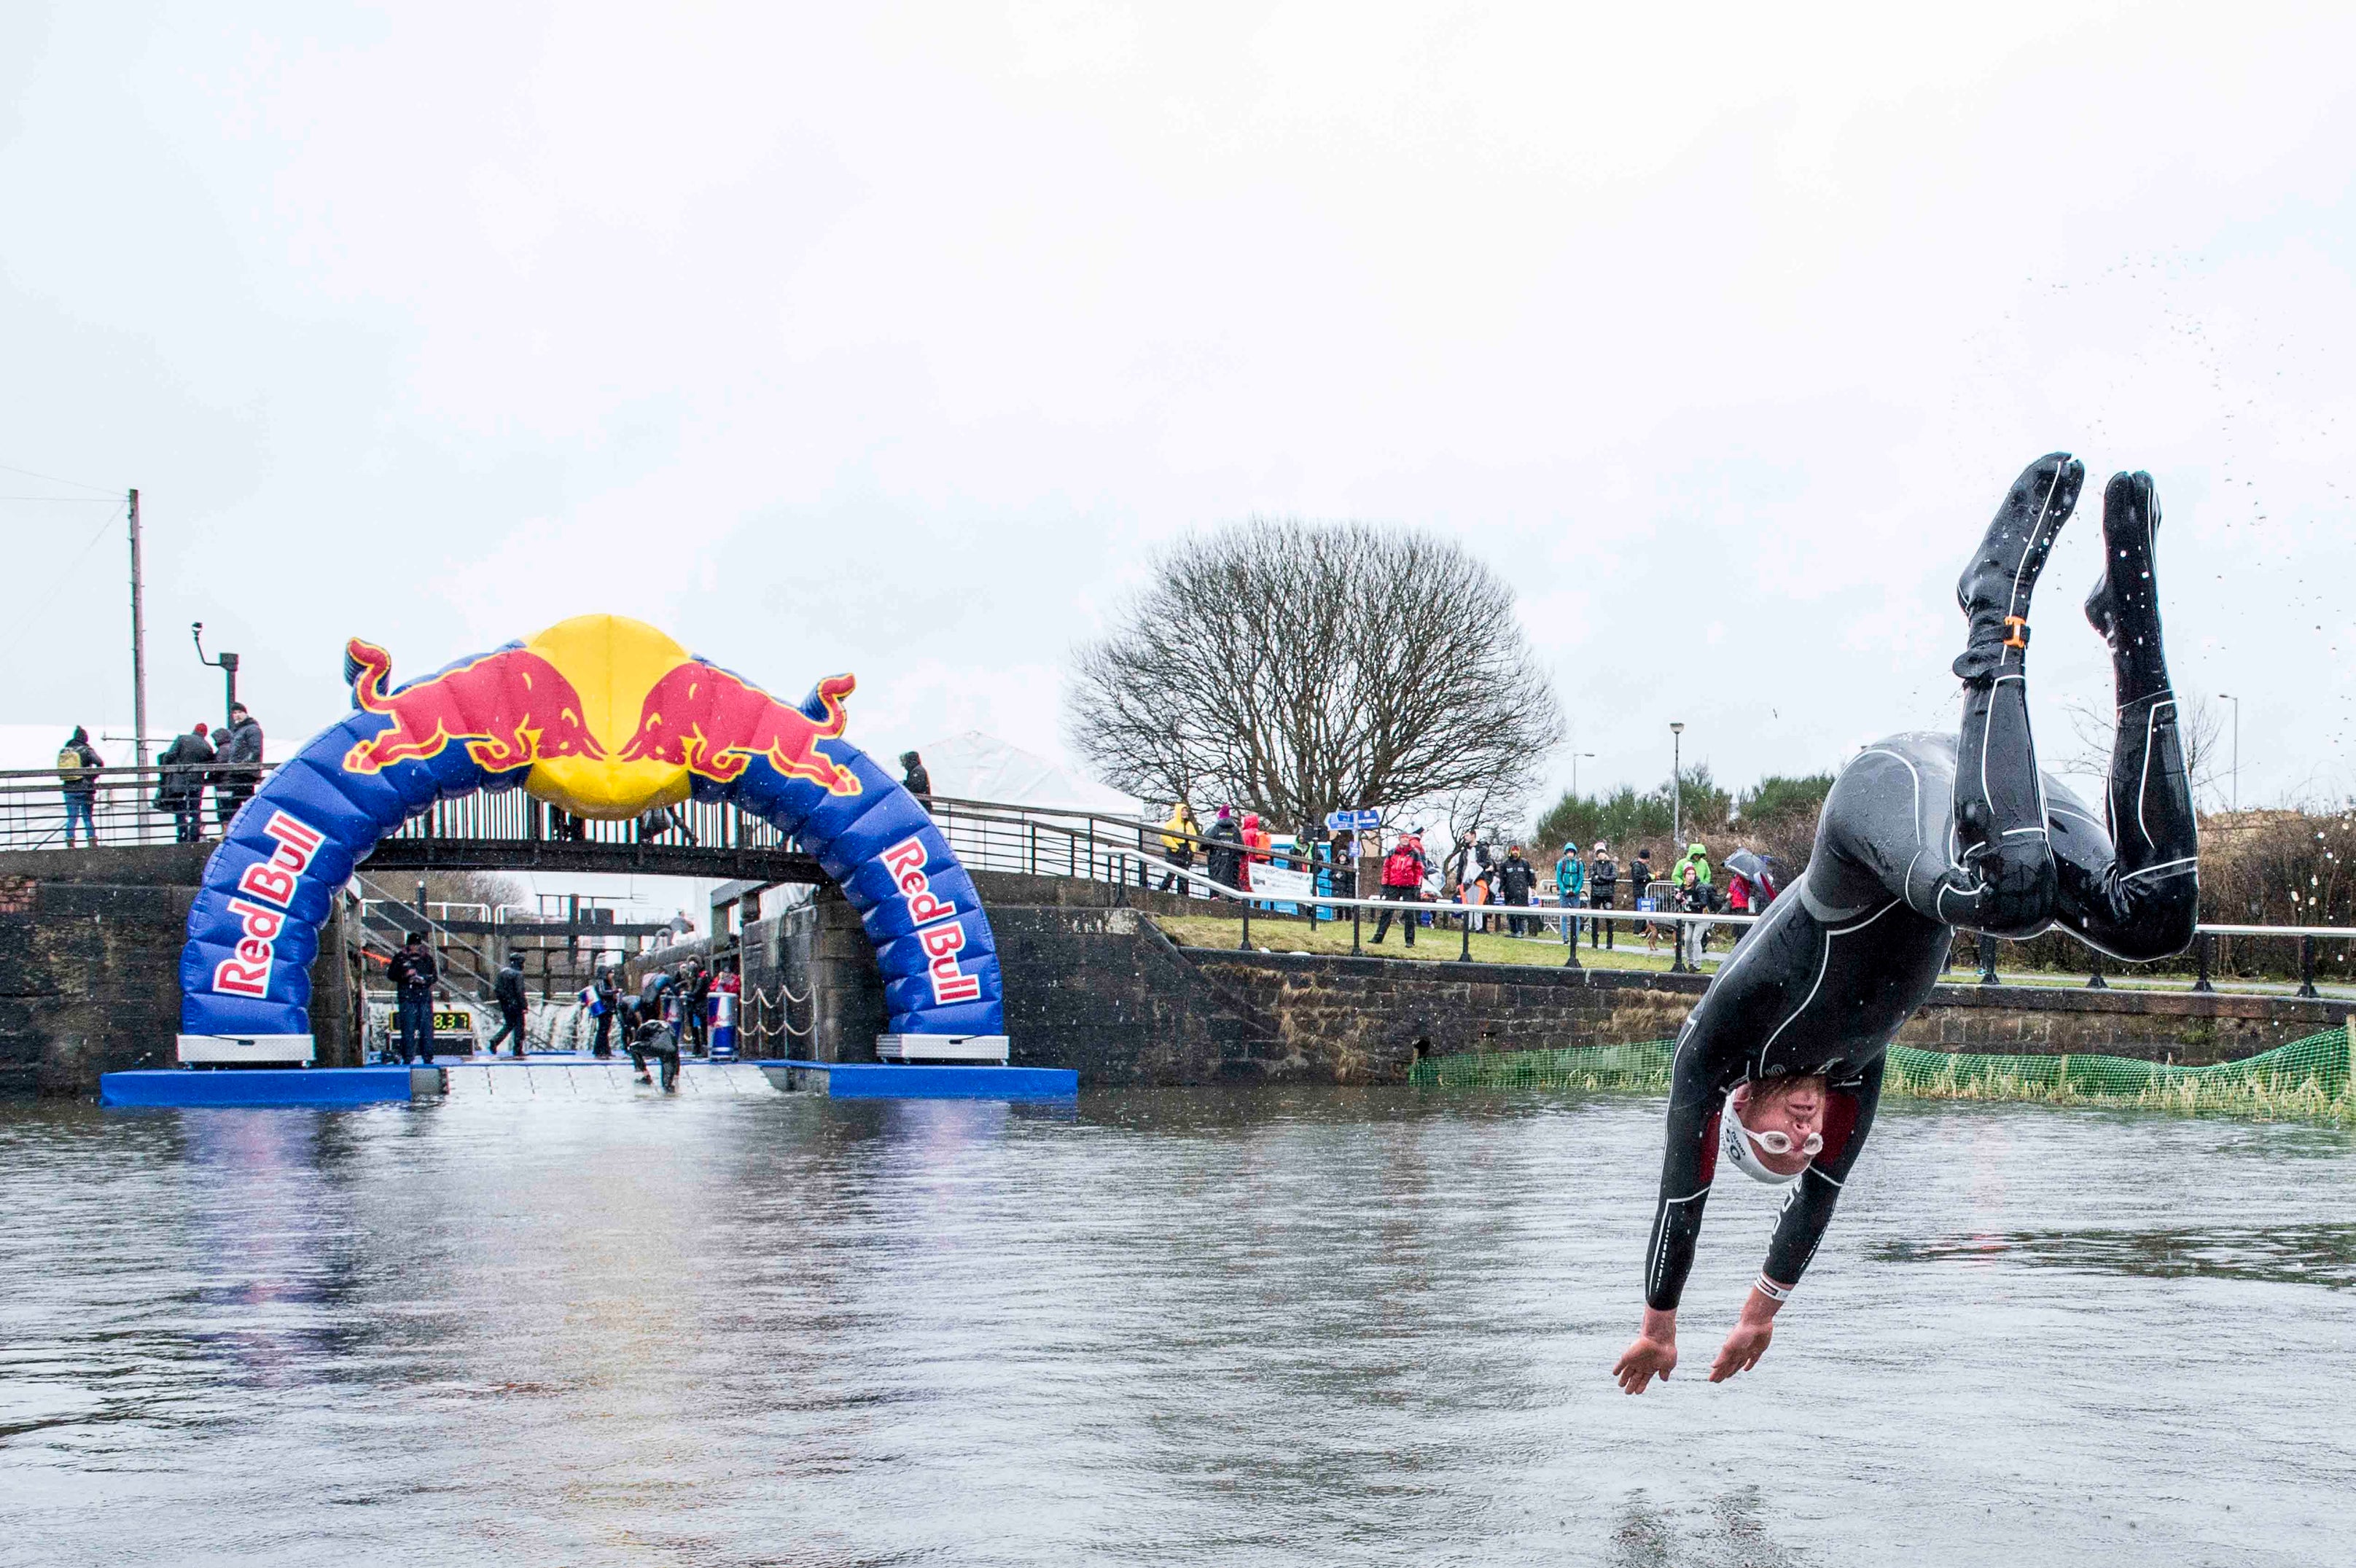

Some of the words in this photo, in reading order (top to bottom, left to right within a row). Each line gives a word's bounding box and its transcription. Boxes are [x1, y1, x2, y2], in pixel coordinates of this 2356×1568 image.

[240, 811, 324, 907] Bull
[881, 838, 956, 925] Red
[215, 899, 285, 997] Red
[918, 922, 980, 1004] Bull
